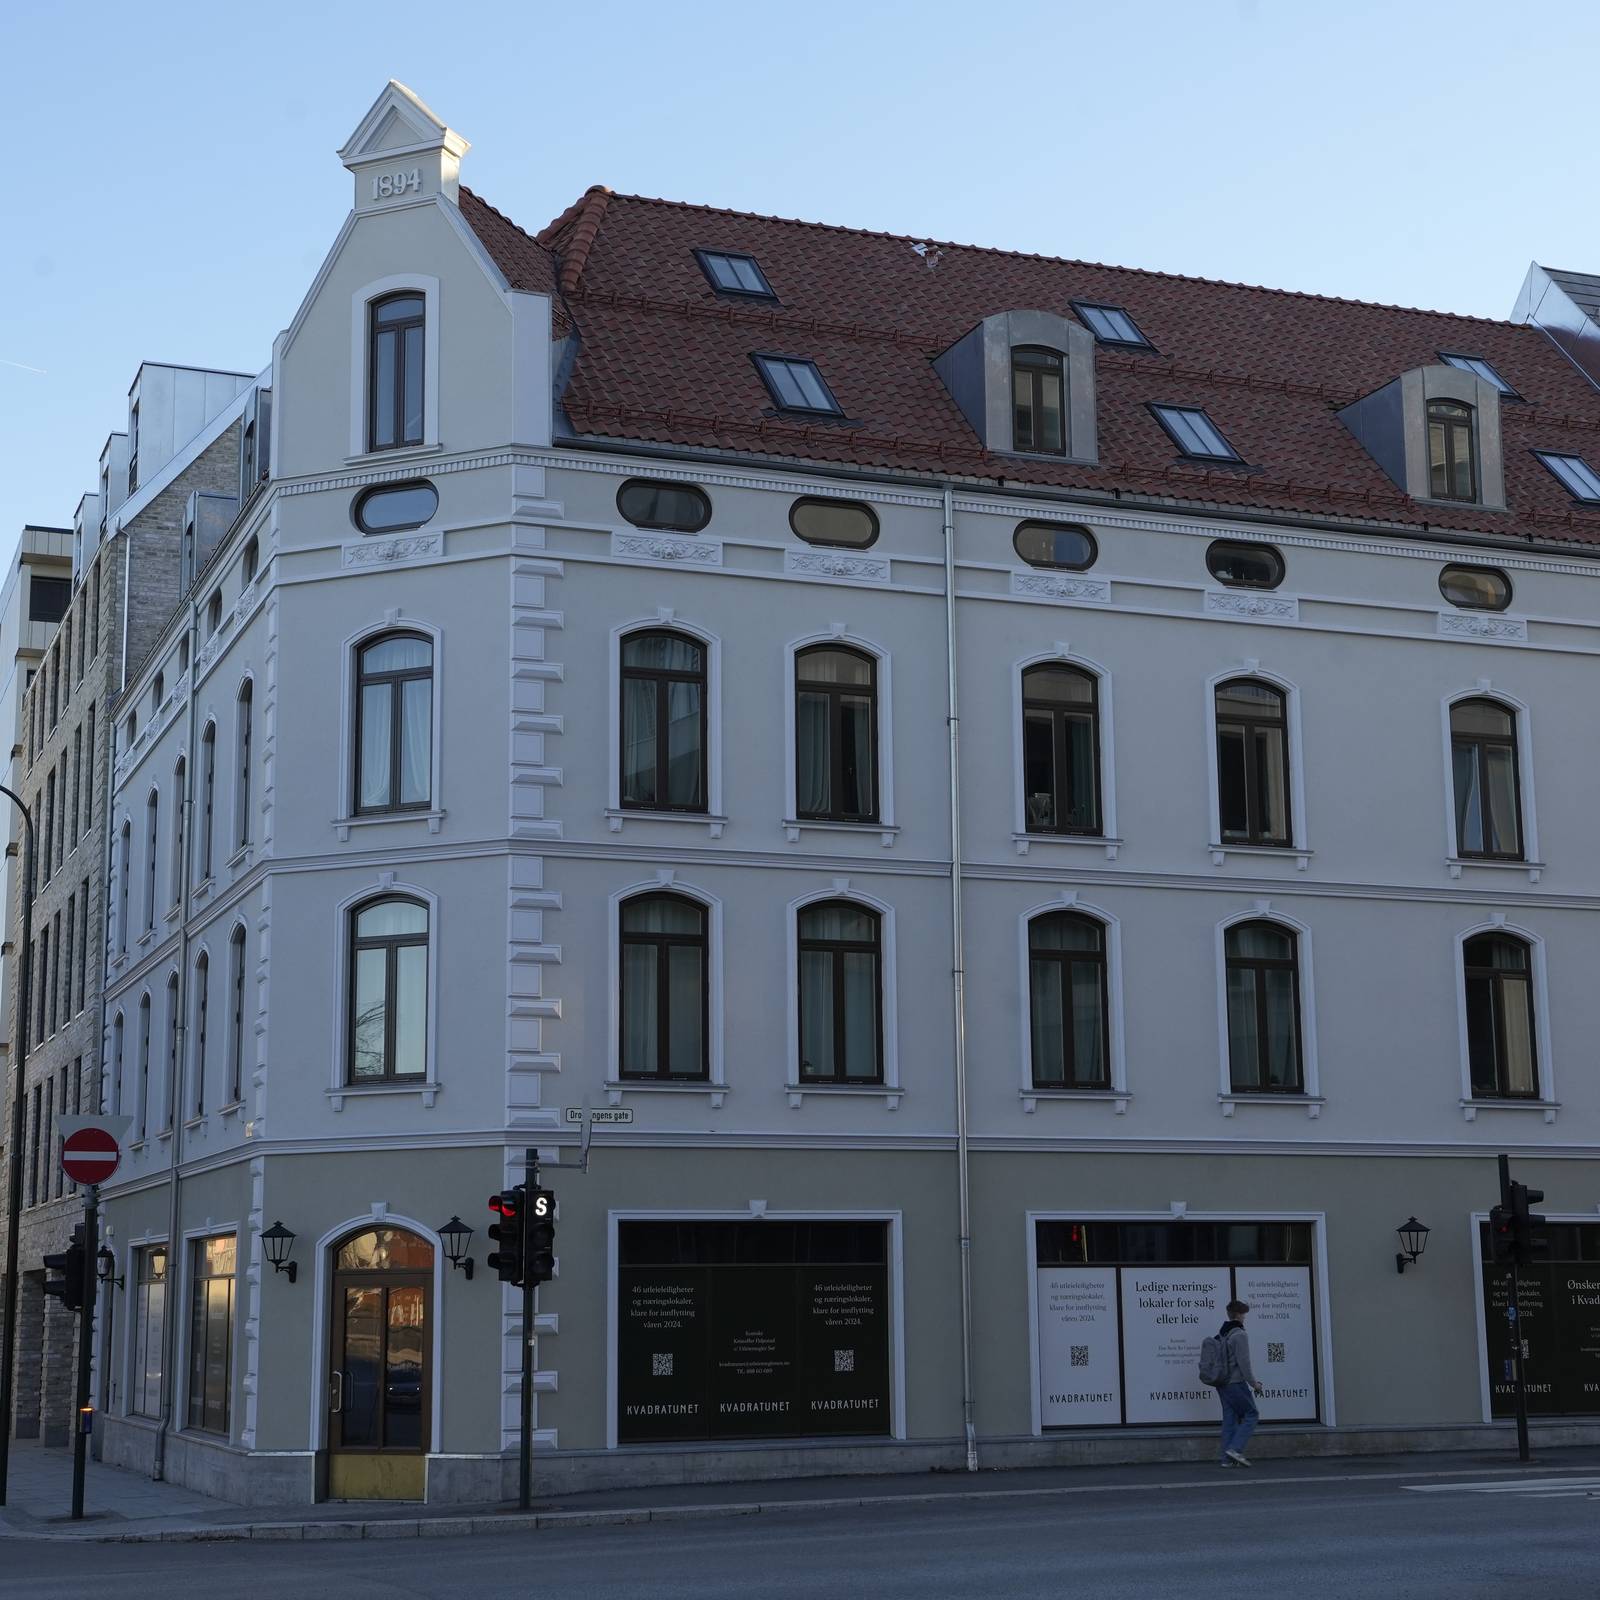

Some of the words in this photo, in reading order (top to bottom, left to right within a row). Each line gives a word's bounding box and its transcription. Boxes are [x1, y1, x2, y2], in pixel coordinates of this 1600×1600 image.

[371, 168, 421, 200] 1894
[570, 1110, 613, 1121] Drongens
[613, 1111, 629, 1121] gate
[535, 1197, 547, 1216] S
[632, 1286, 641, 1294] 46
[813, 1284, 823, 1292] 46
[1135, 1281, 1170, 1294] Ledige
[1172, 1281, 1216, 1294] nærings-
[1567, 1280, 1600, 1290] Ønsker
[632, 1299, 642, 1307] og
[814, 1297, 823, 1305] og
[1139, 1297, 1175, 1308] lokaler
[1177, 1297, 1192, 1308] for
[1193, 1296, 1215, 1310] salg
[1571, 1295, 1575, 1305] i
[630, 1309, 648, 1317] klare
[649, 1309, 659, 1317] for
[812, 1307, 829, 1315] klare
[830, 1306, 840, 1315] for
[1156, 1313, 1179, 1324] eller
[1181, 1313, 1199, 1324] leie
[1050, 1393, 1113, 1403] KVADRATUNET
[1150, 1391, 1212, 1401] KVADRATUNET
[627, 1404, 699, 1415] KVADRATUNET
[720, 1401, 790, 1413] KVADRATUNET
[811, 1399, 879, 1410] KVADRATUNET
